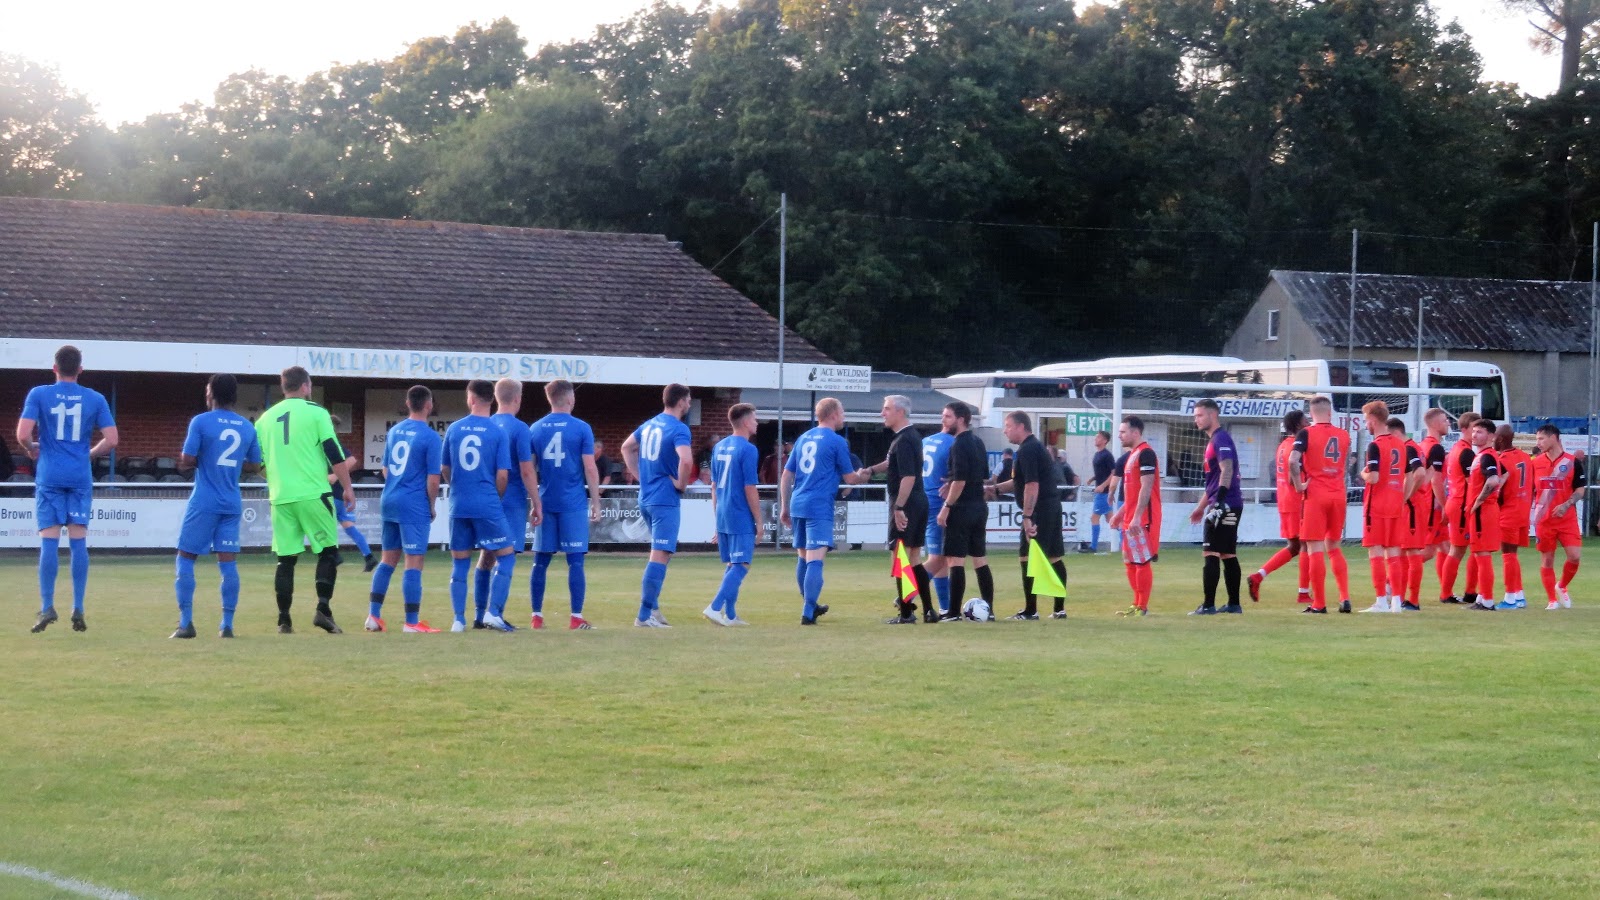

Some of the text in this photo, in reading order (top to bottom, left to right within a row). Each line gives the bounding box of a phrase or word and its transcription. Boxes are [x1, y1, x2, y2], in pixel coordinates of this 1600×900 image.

[308, 351, 590, 378] WILLIAM PICKFORD STAND
[821, 368, 834, 376] ACE
[51, 402, 82, 441] 11
[276, 411, 290, 445] 1
[1078, 416, 1108, 431] EXIT
[216, 428, 242, 467] 2
[389, 440, 411, 477] 9
[459, 434, 482, 472] 6
[543, 431, 566, 467] 4
[641, 425, 663, 461] 10
[799, 440, 818, 474] 8
[1324, 436, 1341, 463] 4
[717, 454, 732, 489] 7
[922, 445, 937, 477] 5
[1389, 448, 1400, 475] 2
[1514, 461, 1526, 488] 1
[1, 508, 33, 520] Brown
[97, 509, 137, 522] Building
